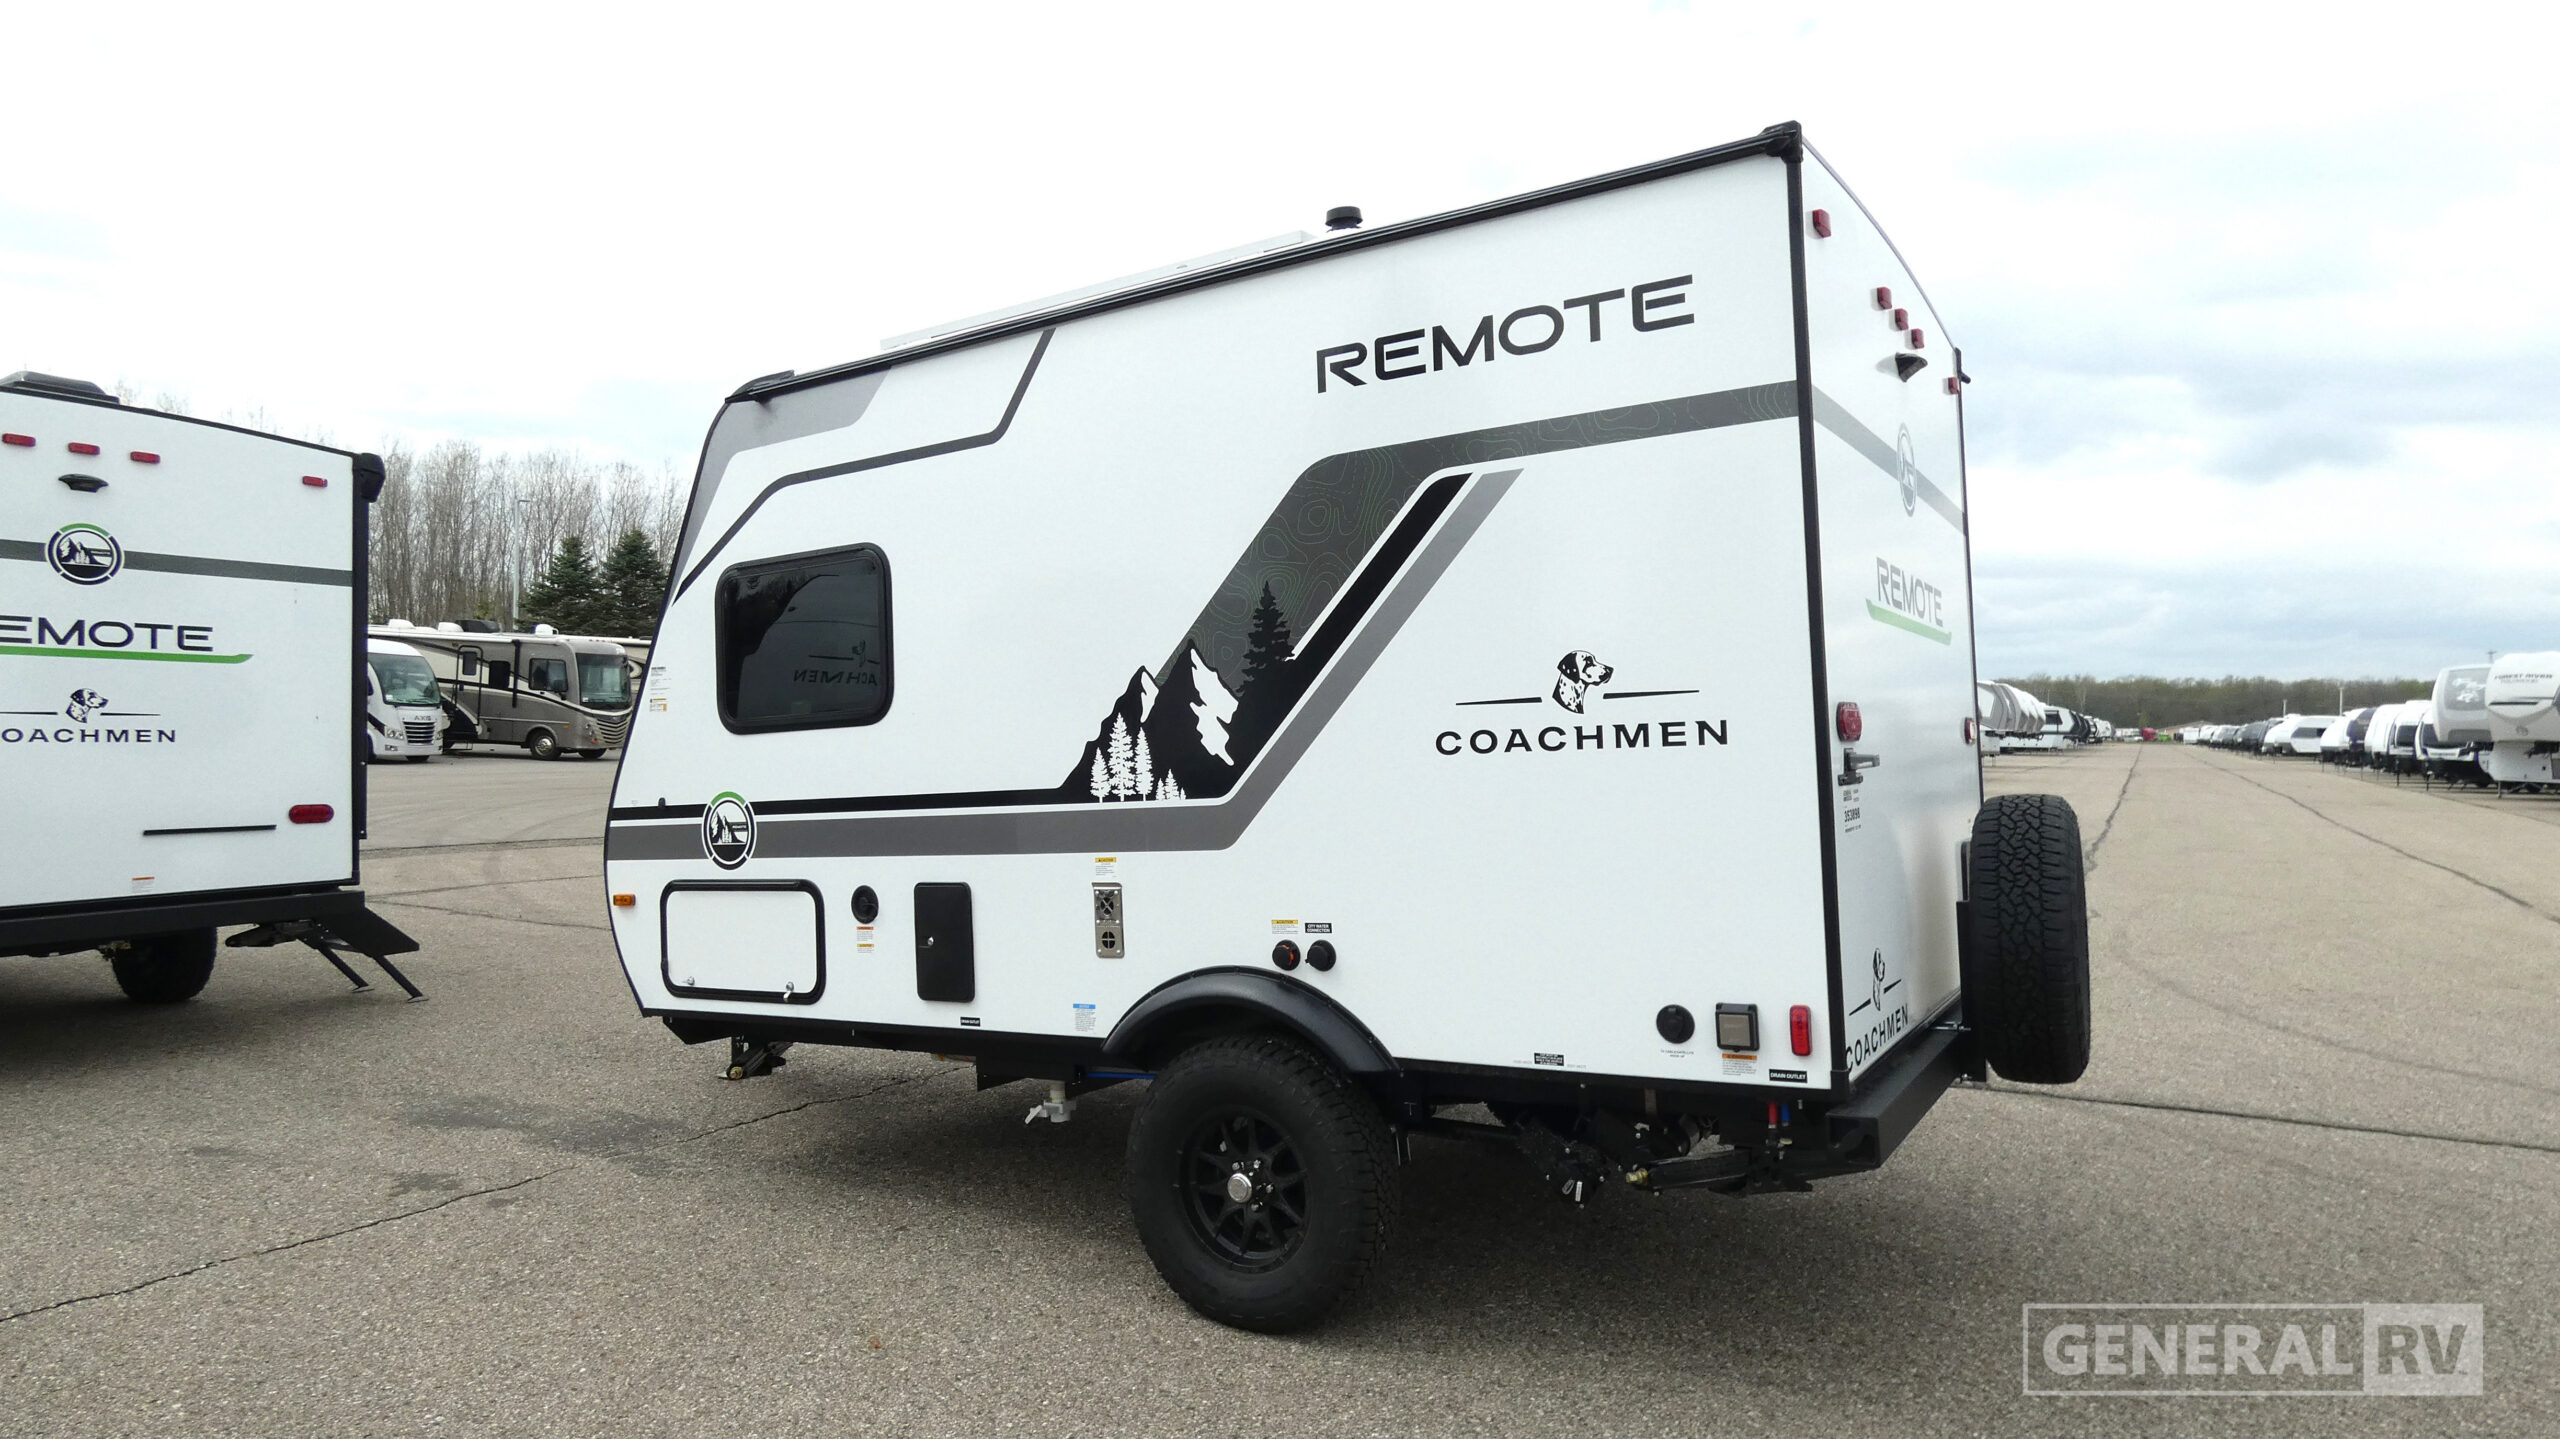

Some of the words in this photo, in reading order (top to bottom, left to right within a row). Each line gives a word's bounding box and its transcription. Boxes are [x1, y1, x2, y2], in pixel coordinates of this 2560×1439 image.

[1316, 274, 1695, 394] REMOTE
[1876, 557, 1944, 628] REMOTE
[0, 615, 213, 652] EMOTE
[1, 728, 176, 743] OACHMEN
[1435, 719, 1728, 756] COACHMEN
[1846, 1003, 1908, 1073] COACHMEN
